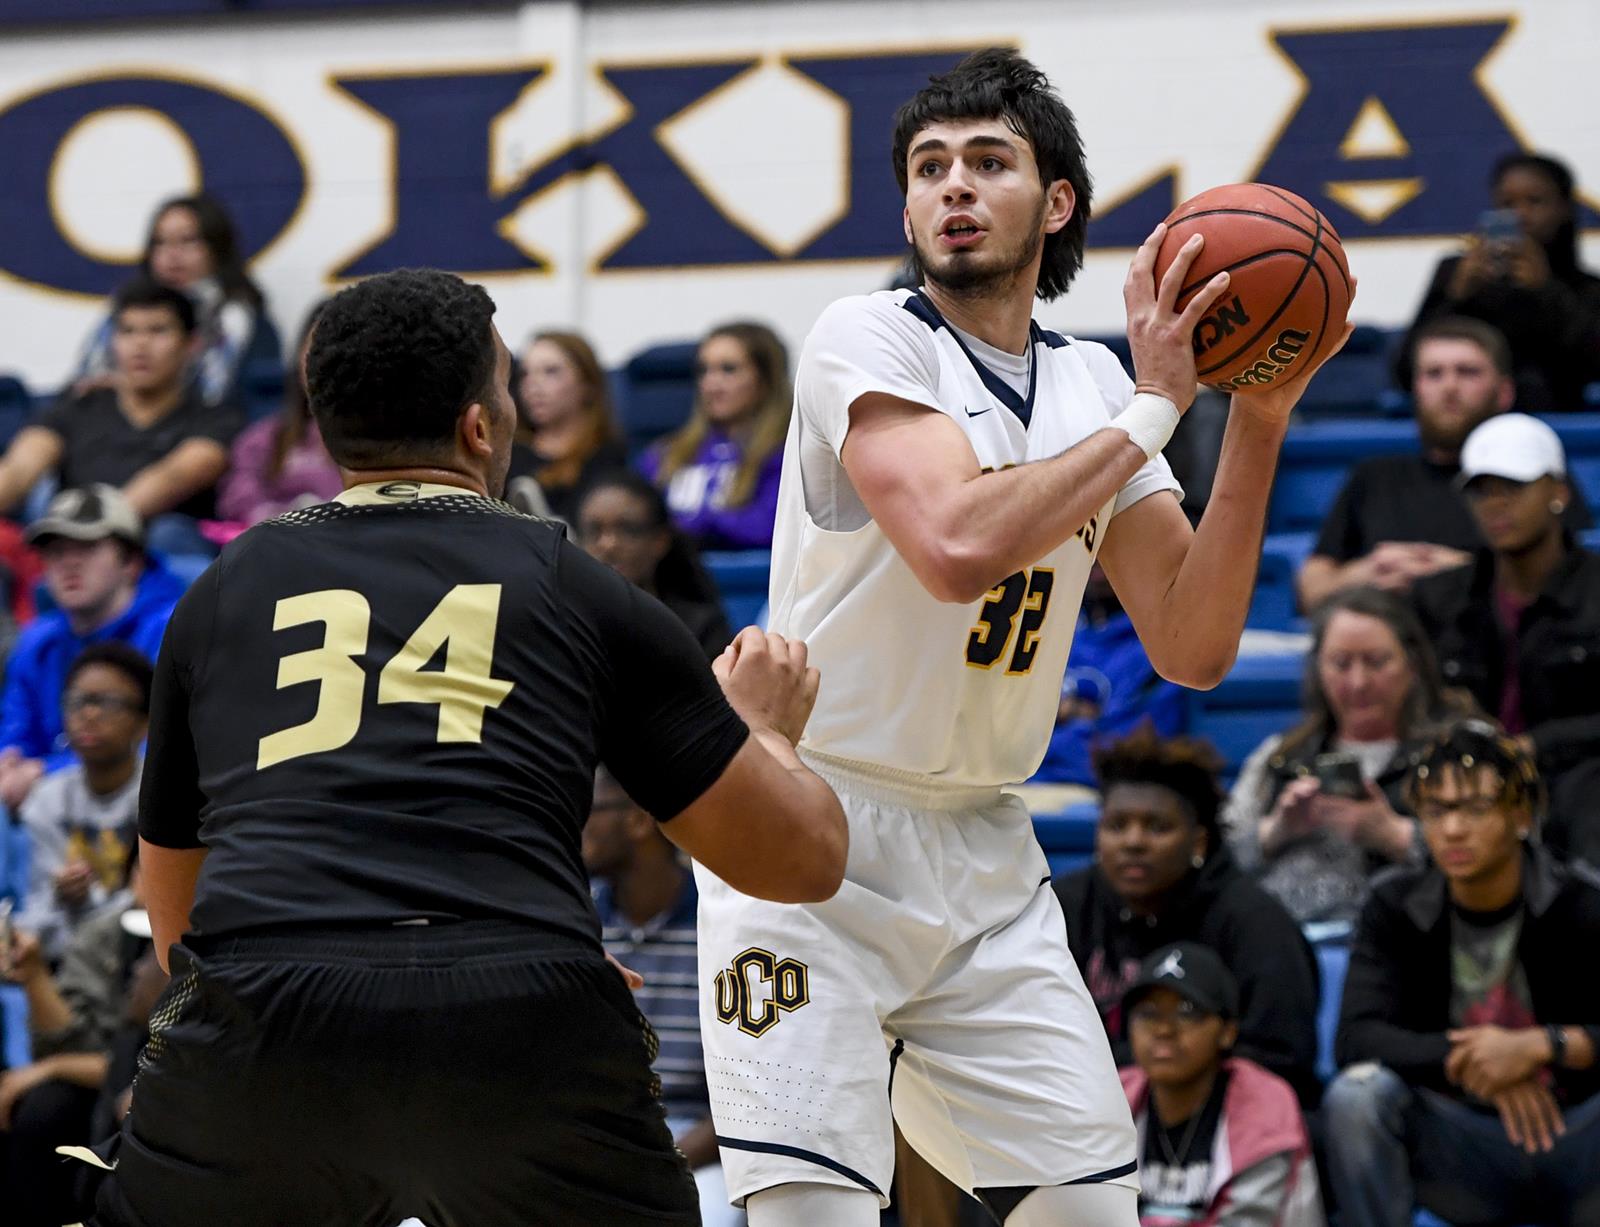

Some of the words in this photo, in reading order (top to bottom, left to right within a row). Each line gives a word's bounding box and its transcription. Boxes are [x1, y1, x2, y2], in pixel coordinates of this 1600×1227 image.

[964, 566, 1055, 676] 32
[256, 583, 516, 771] 34
[713, 946, 810, 1039] UCO
